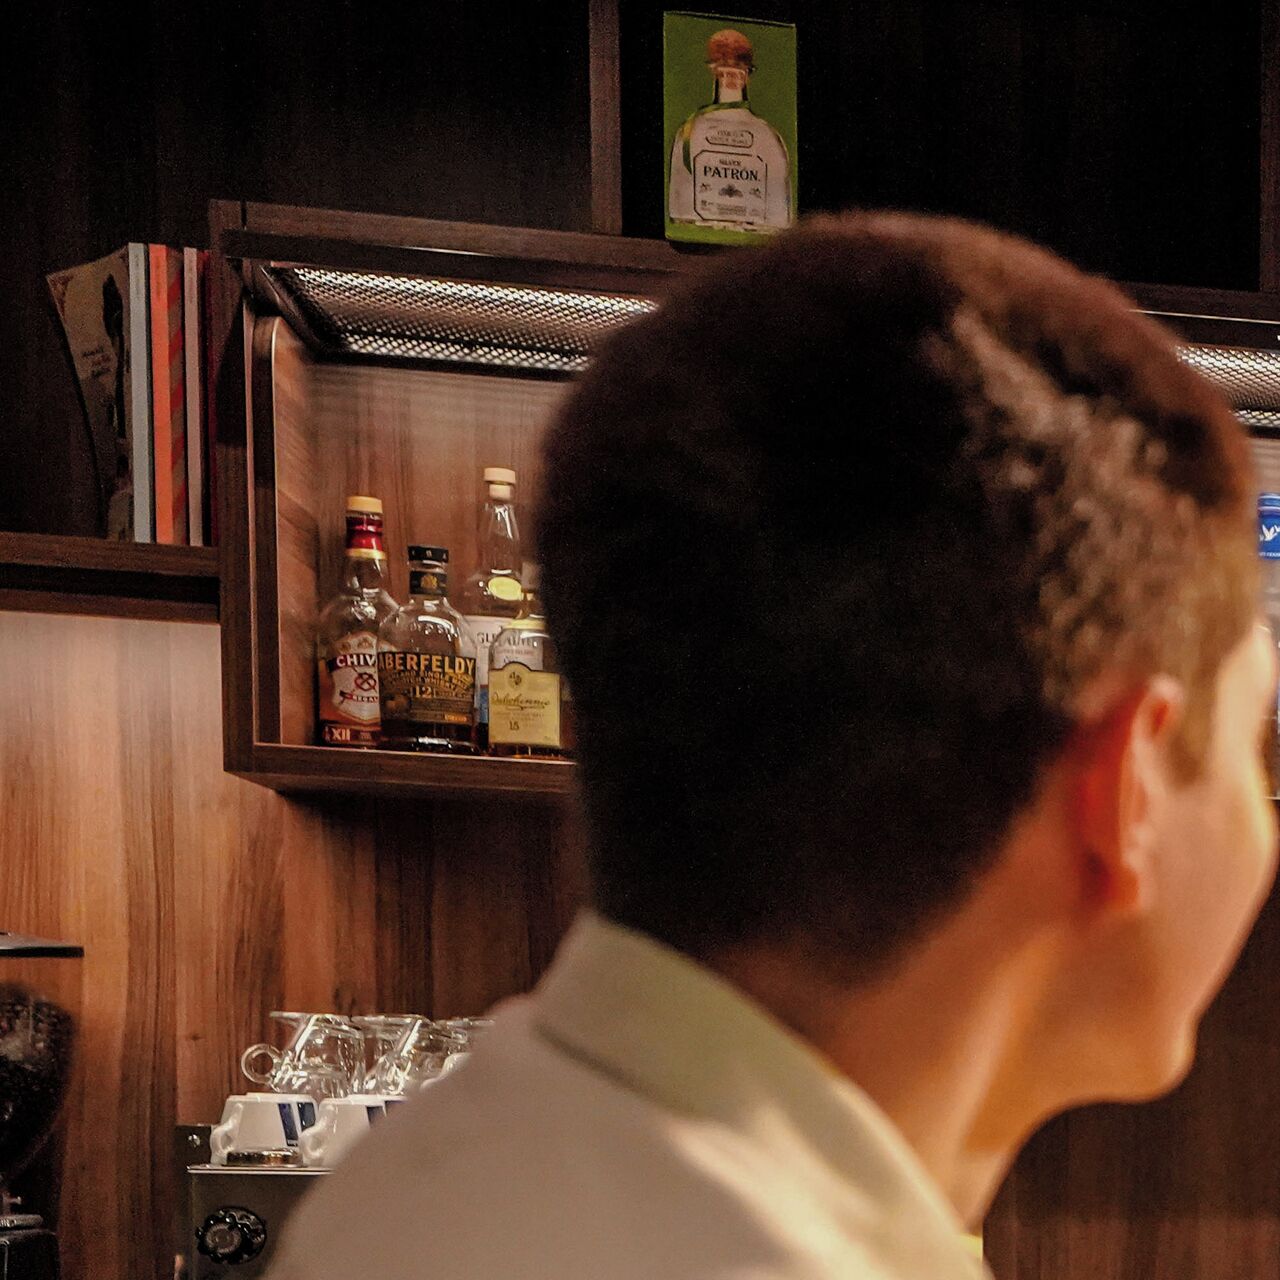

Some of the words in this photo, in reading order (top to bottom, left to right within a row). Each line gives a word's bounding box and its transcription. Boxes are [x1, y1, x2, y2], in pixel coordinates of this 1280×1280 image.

[336, 653, 377, 668] CHIV
[378, 652, 475, 676] ABERFELDY
[414, 685, 432, 699] 12
